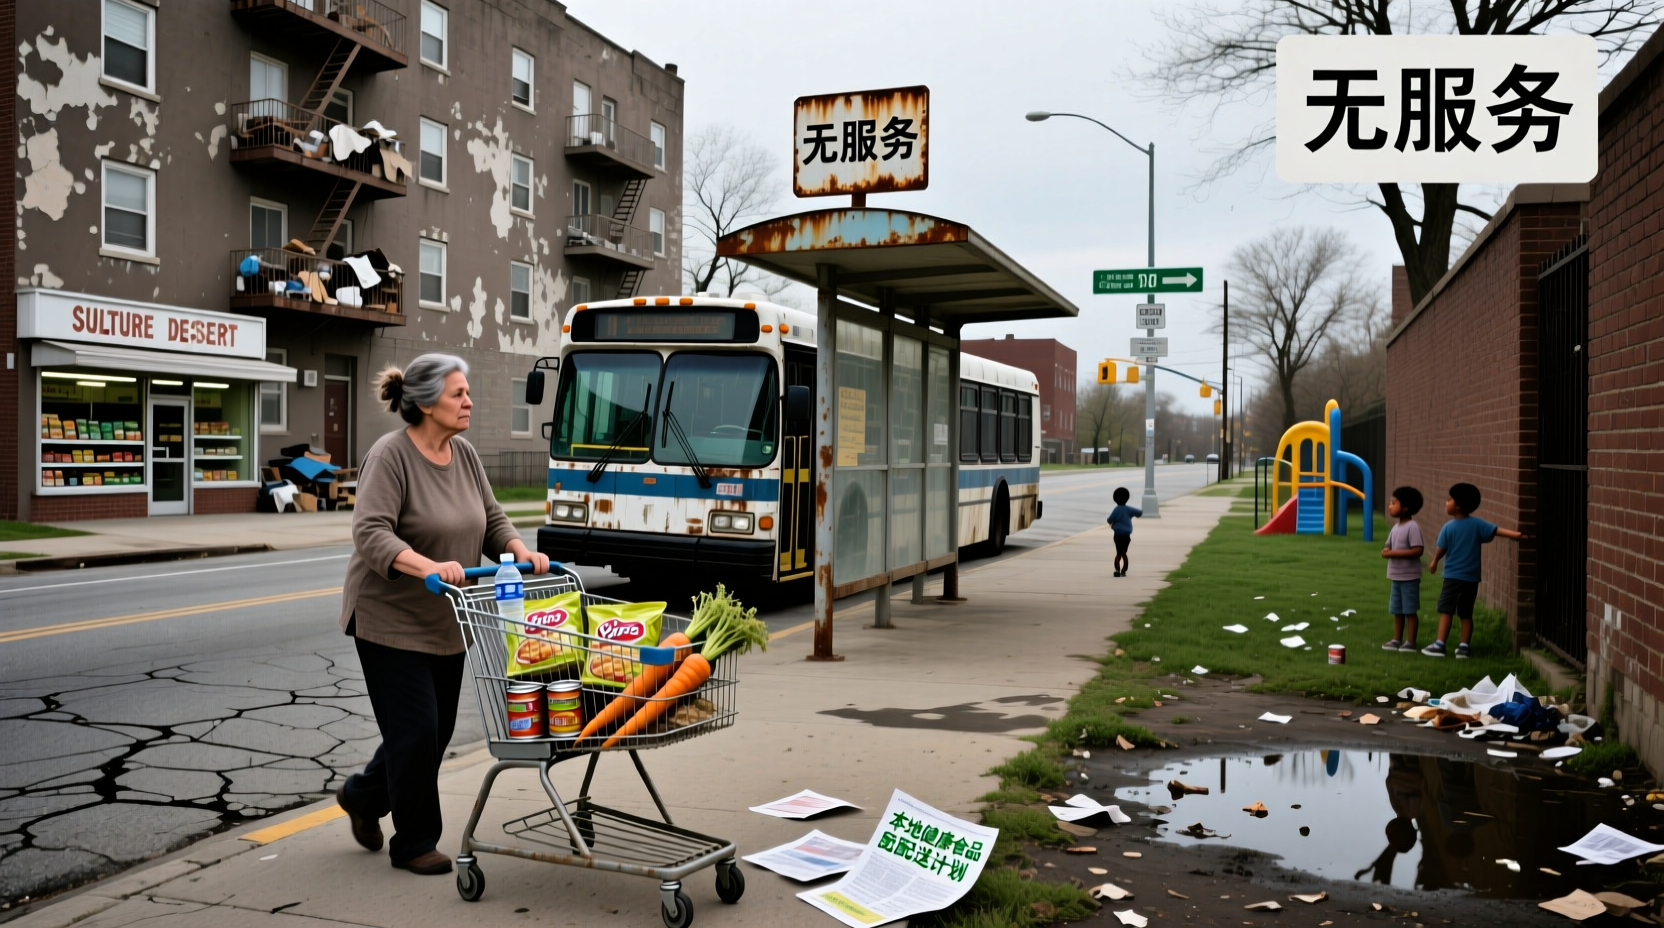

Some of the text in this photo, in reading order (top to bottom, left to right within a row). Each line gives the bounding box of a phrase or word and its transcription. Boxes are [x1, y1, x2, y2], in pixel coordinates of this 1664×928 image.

[802, 115, 918, 166] 无服务
[72, 305, 154, 339] SULTURE
